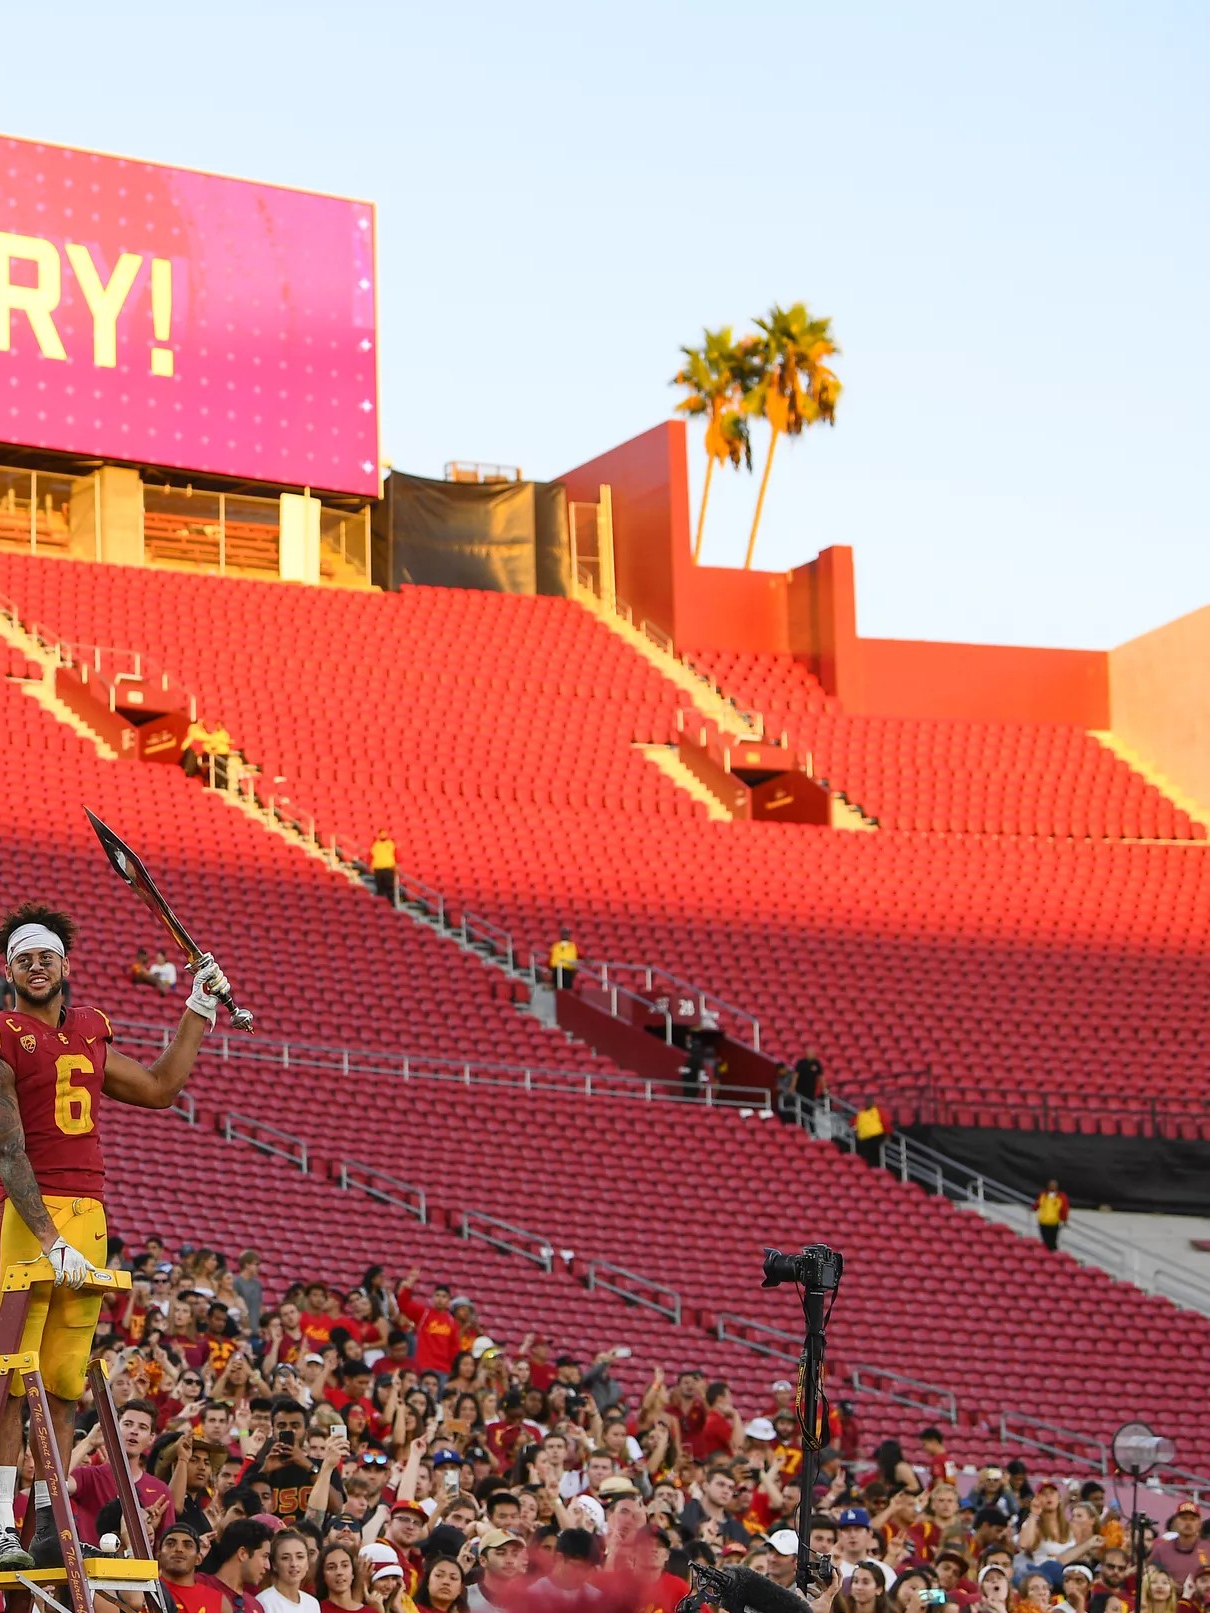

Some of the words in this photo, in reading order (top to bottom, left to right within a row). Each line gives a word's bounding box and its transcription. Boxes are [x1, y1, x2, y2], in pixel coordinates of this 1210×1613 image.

[54, 1054, 95, 1135] 6
[33, 1403, 43, 1423] The
[37, 1426, 51, 1457] Spirit
[44, 1460, 55, 1470] of
[49, 1472, 59, 1497] Troy
[66, 1547, 77, 1566] The
[71, 1571, 84, 1602] Spirit
